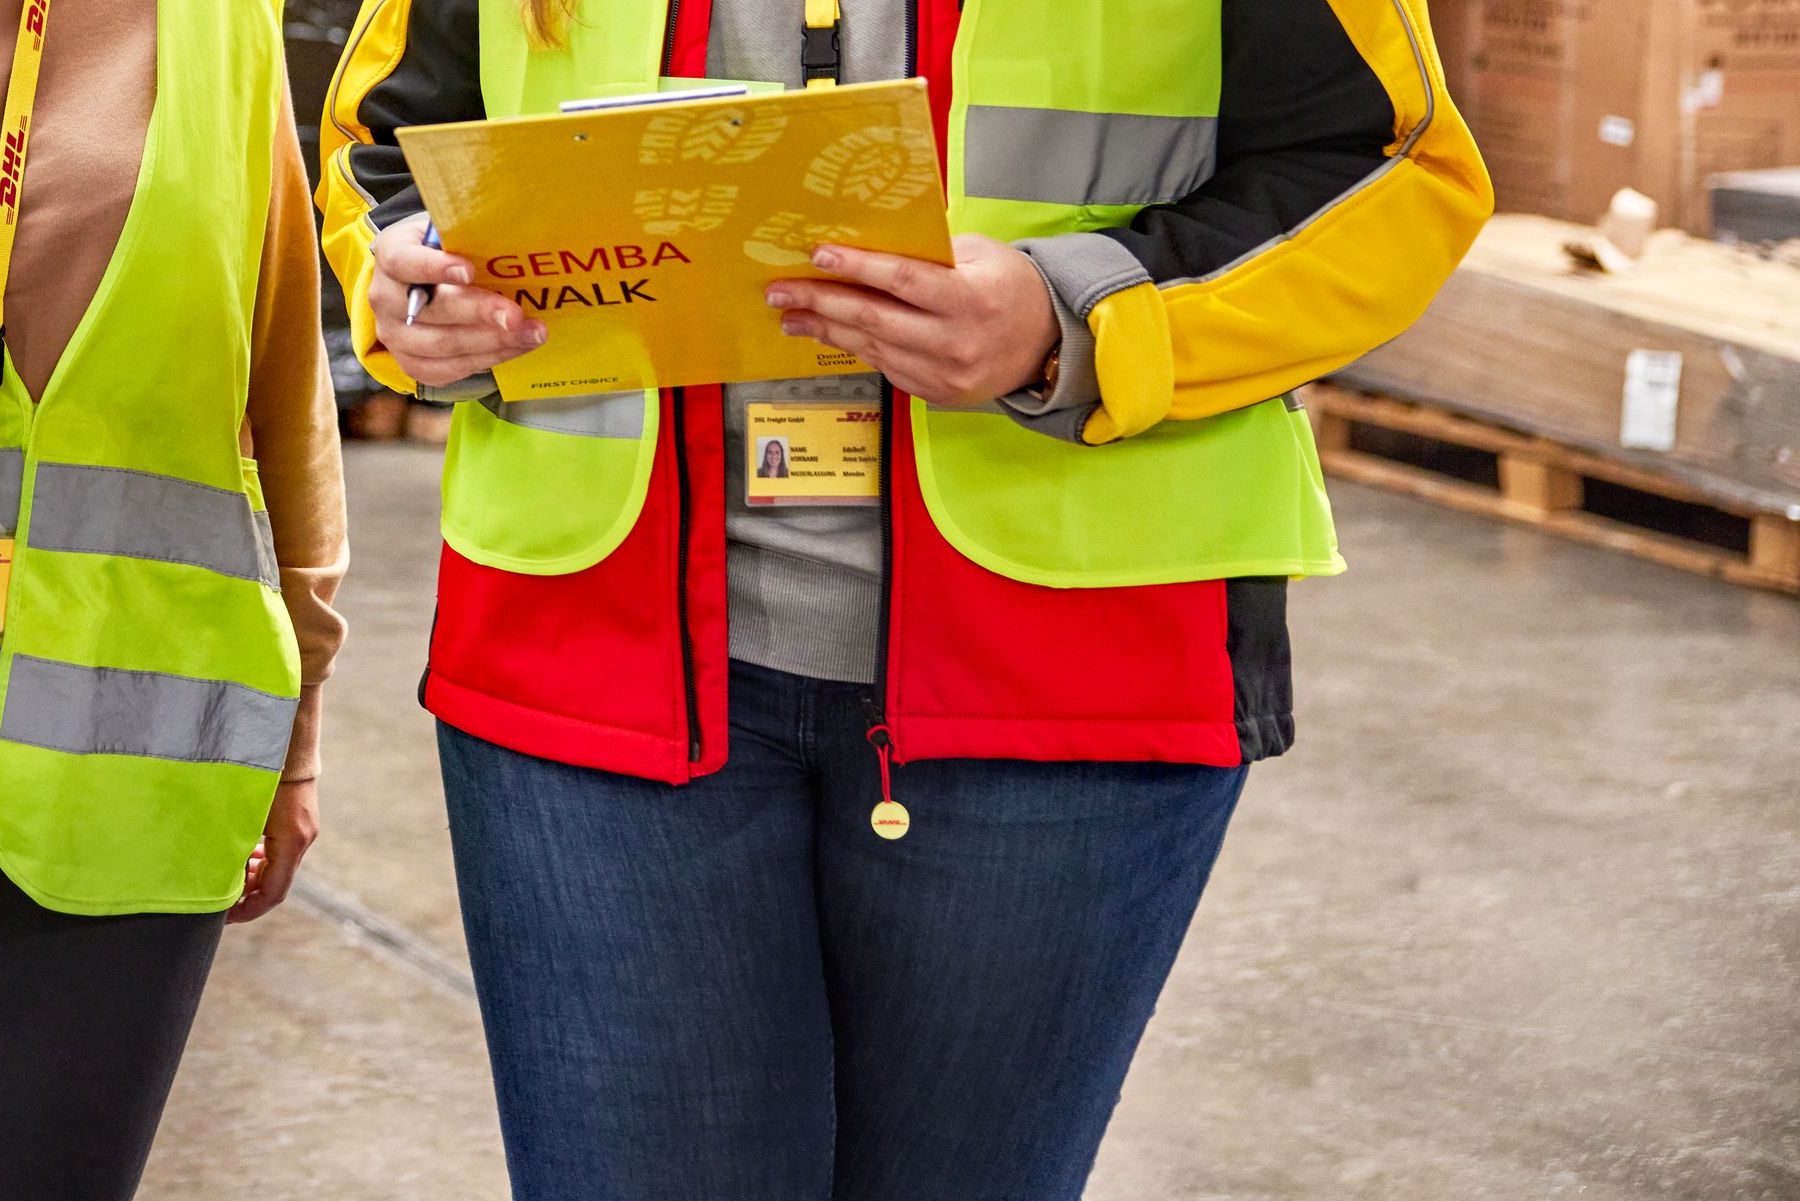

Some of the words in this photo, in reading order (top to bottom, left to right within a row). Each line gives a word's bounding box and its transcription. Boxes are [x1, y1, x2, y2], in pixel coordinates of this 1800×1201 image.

[486, 241, 692, 279] GEMBA
[817, 359, 857, 367] Group
[531, 380, 567, 389] FIRST
[845, 411, 881, 422] DH
